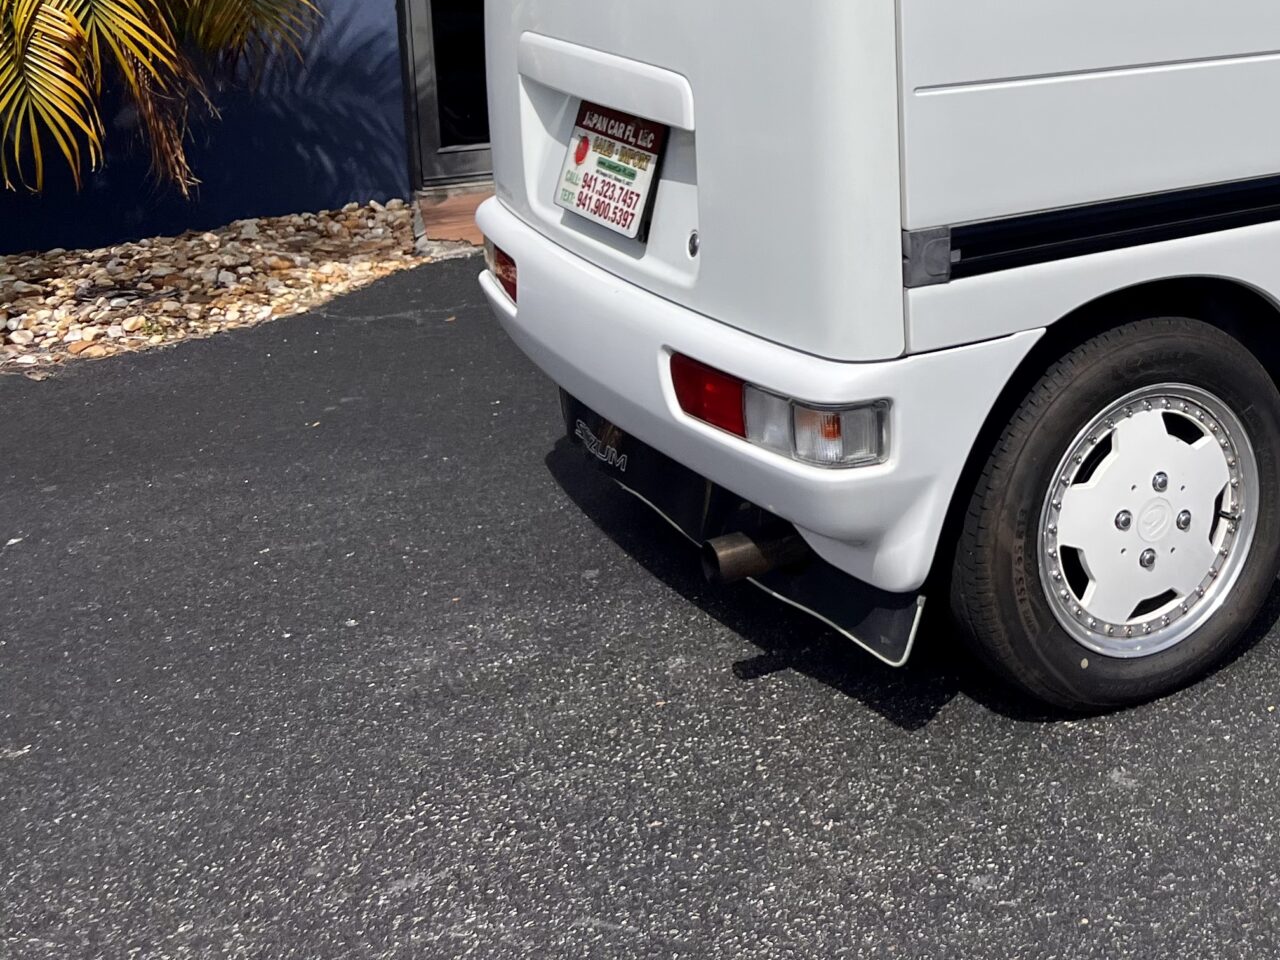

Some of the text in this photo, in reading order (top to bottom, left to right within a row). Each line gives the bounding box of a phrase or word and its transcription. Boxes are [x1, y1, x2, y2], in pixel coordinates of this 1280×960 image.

[582, 111, 608, 133] JAPAN
[607, 119, 625, 137] CAR
[576, 191, 636, 230] 941.900.5397
[581, 172, 641, 211] 941.323.7457
